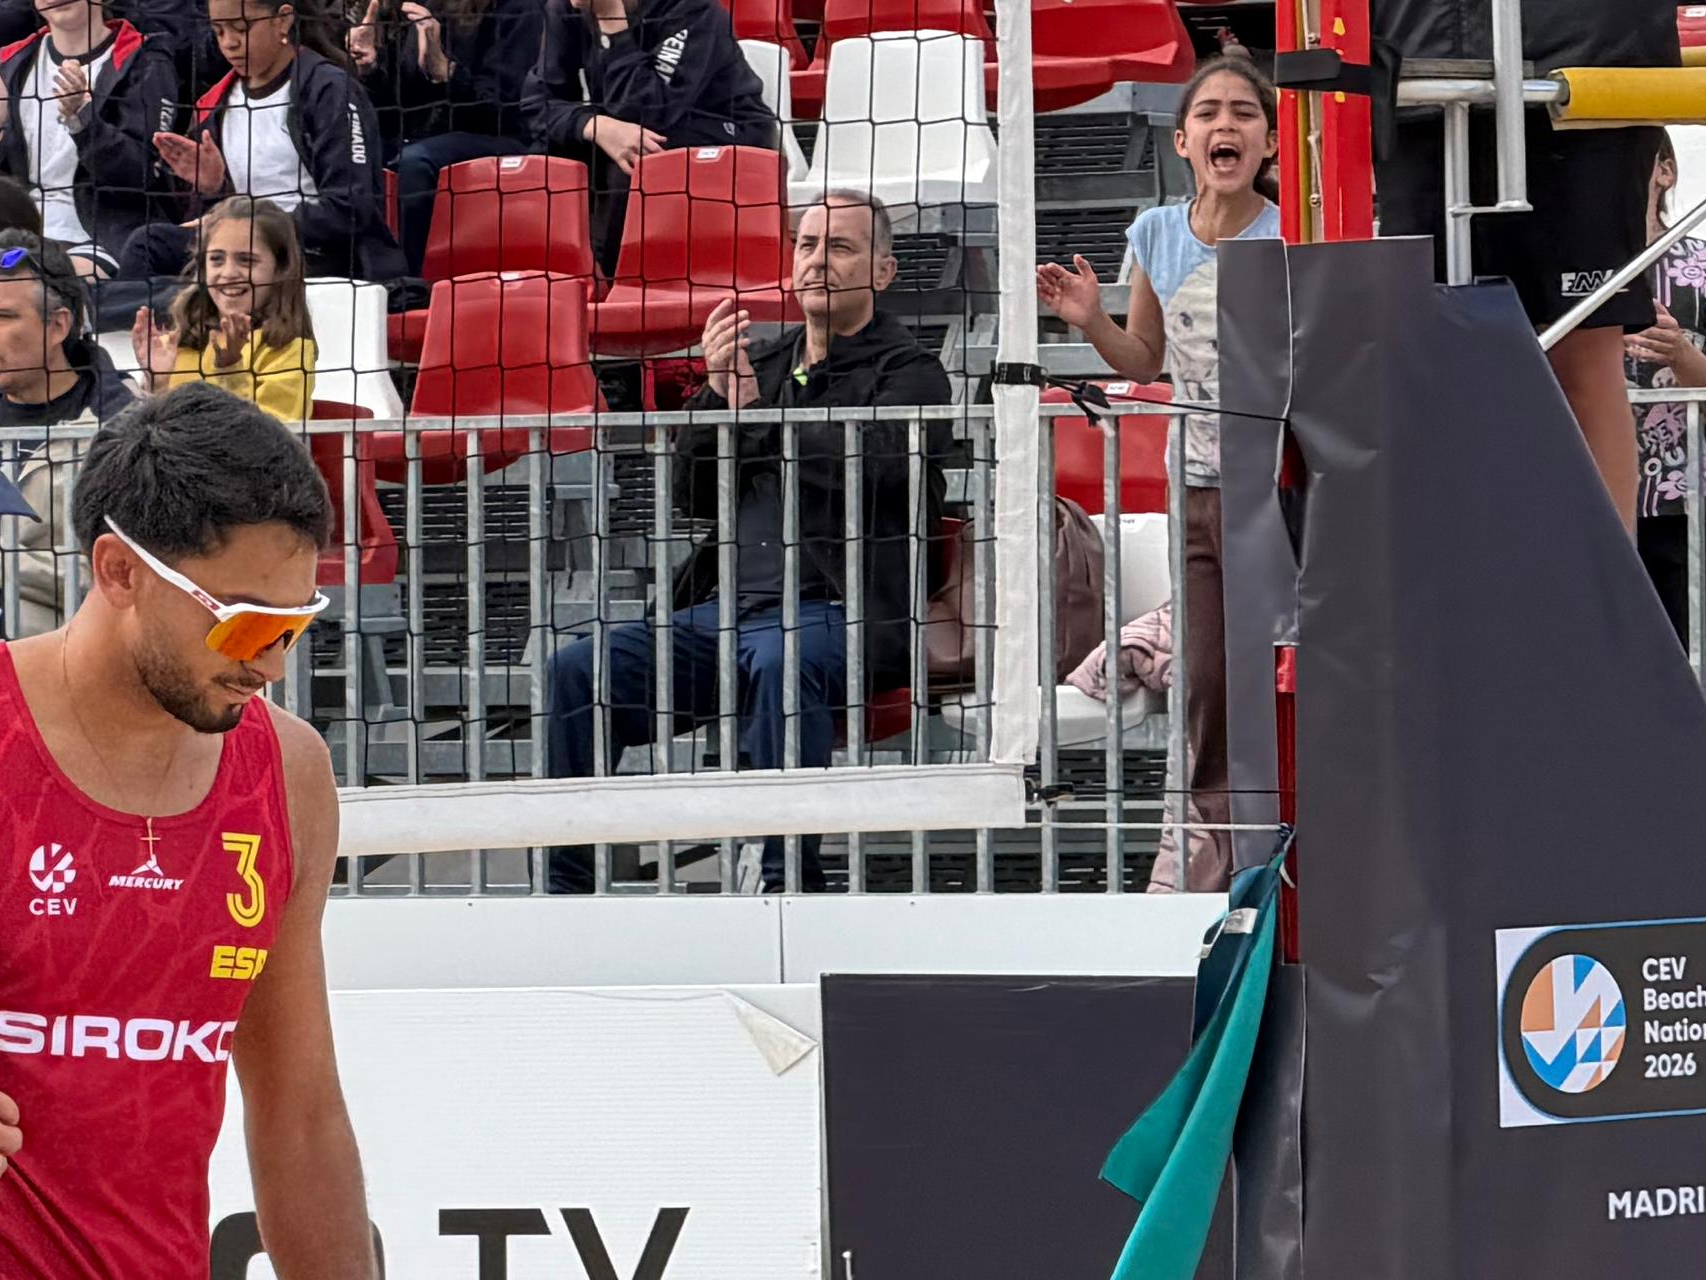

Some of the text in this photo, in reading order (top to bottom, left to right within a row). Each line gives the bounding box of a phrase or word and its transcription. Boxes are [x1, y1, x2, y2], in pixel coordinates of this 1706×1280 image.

[108, 875, 185, 891] MERCURY
[222, 831, 266, 928] 3
[29, 898, 78, 916] CEV
[1642, 956, 1687, 982] CEV
[1644, 1052, 1697, 1078] 2026
